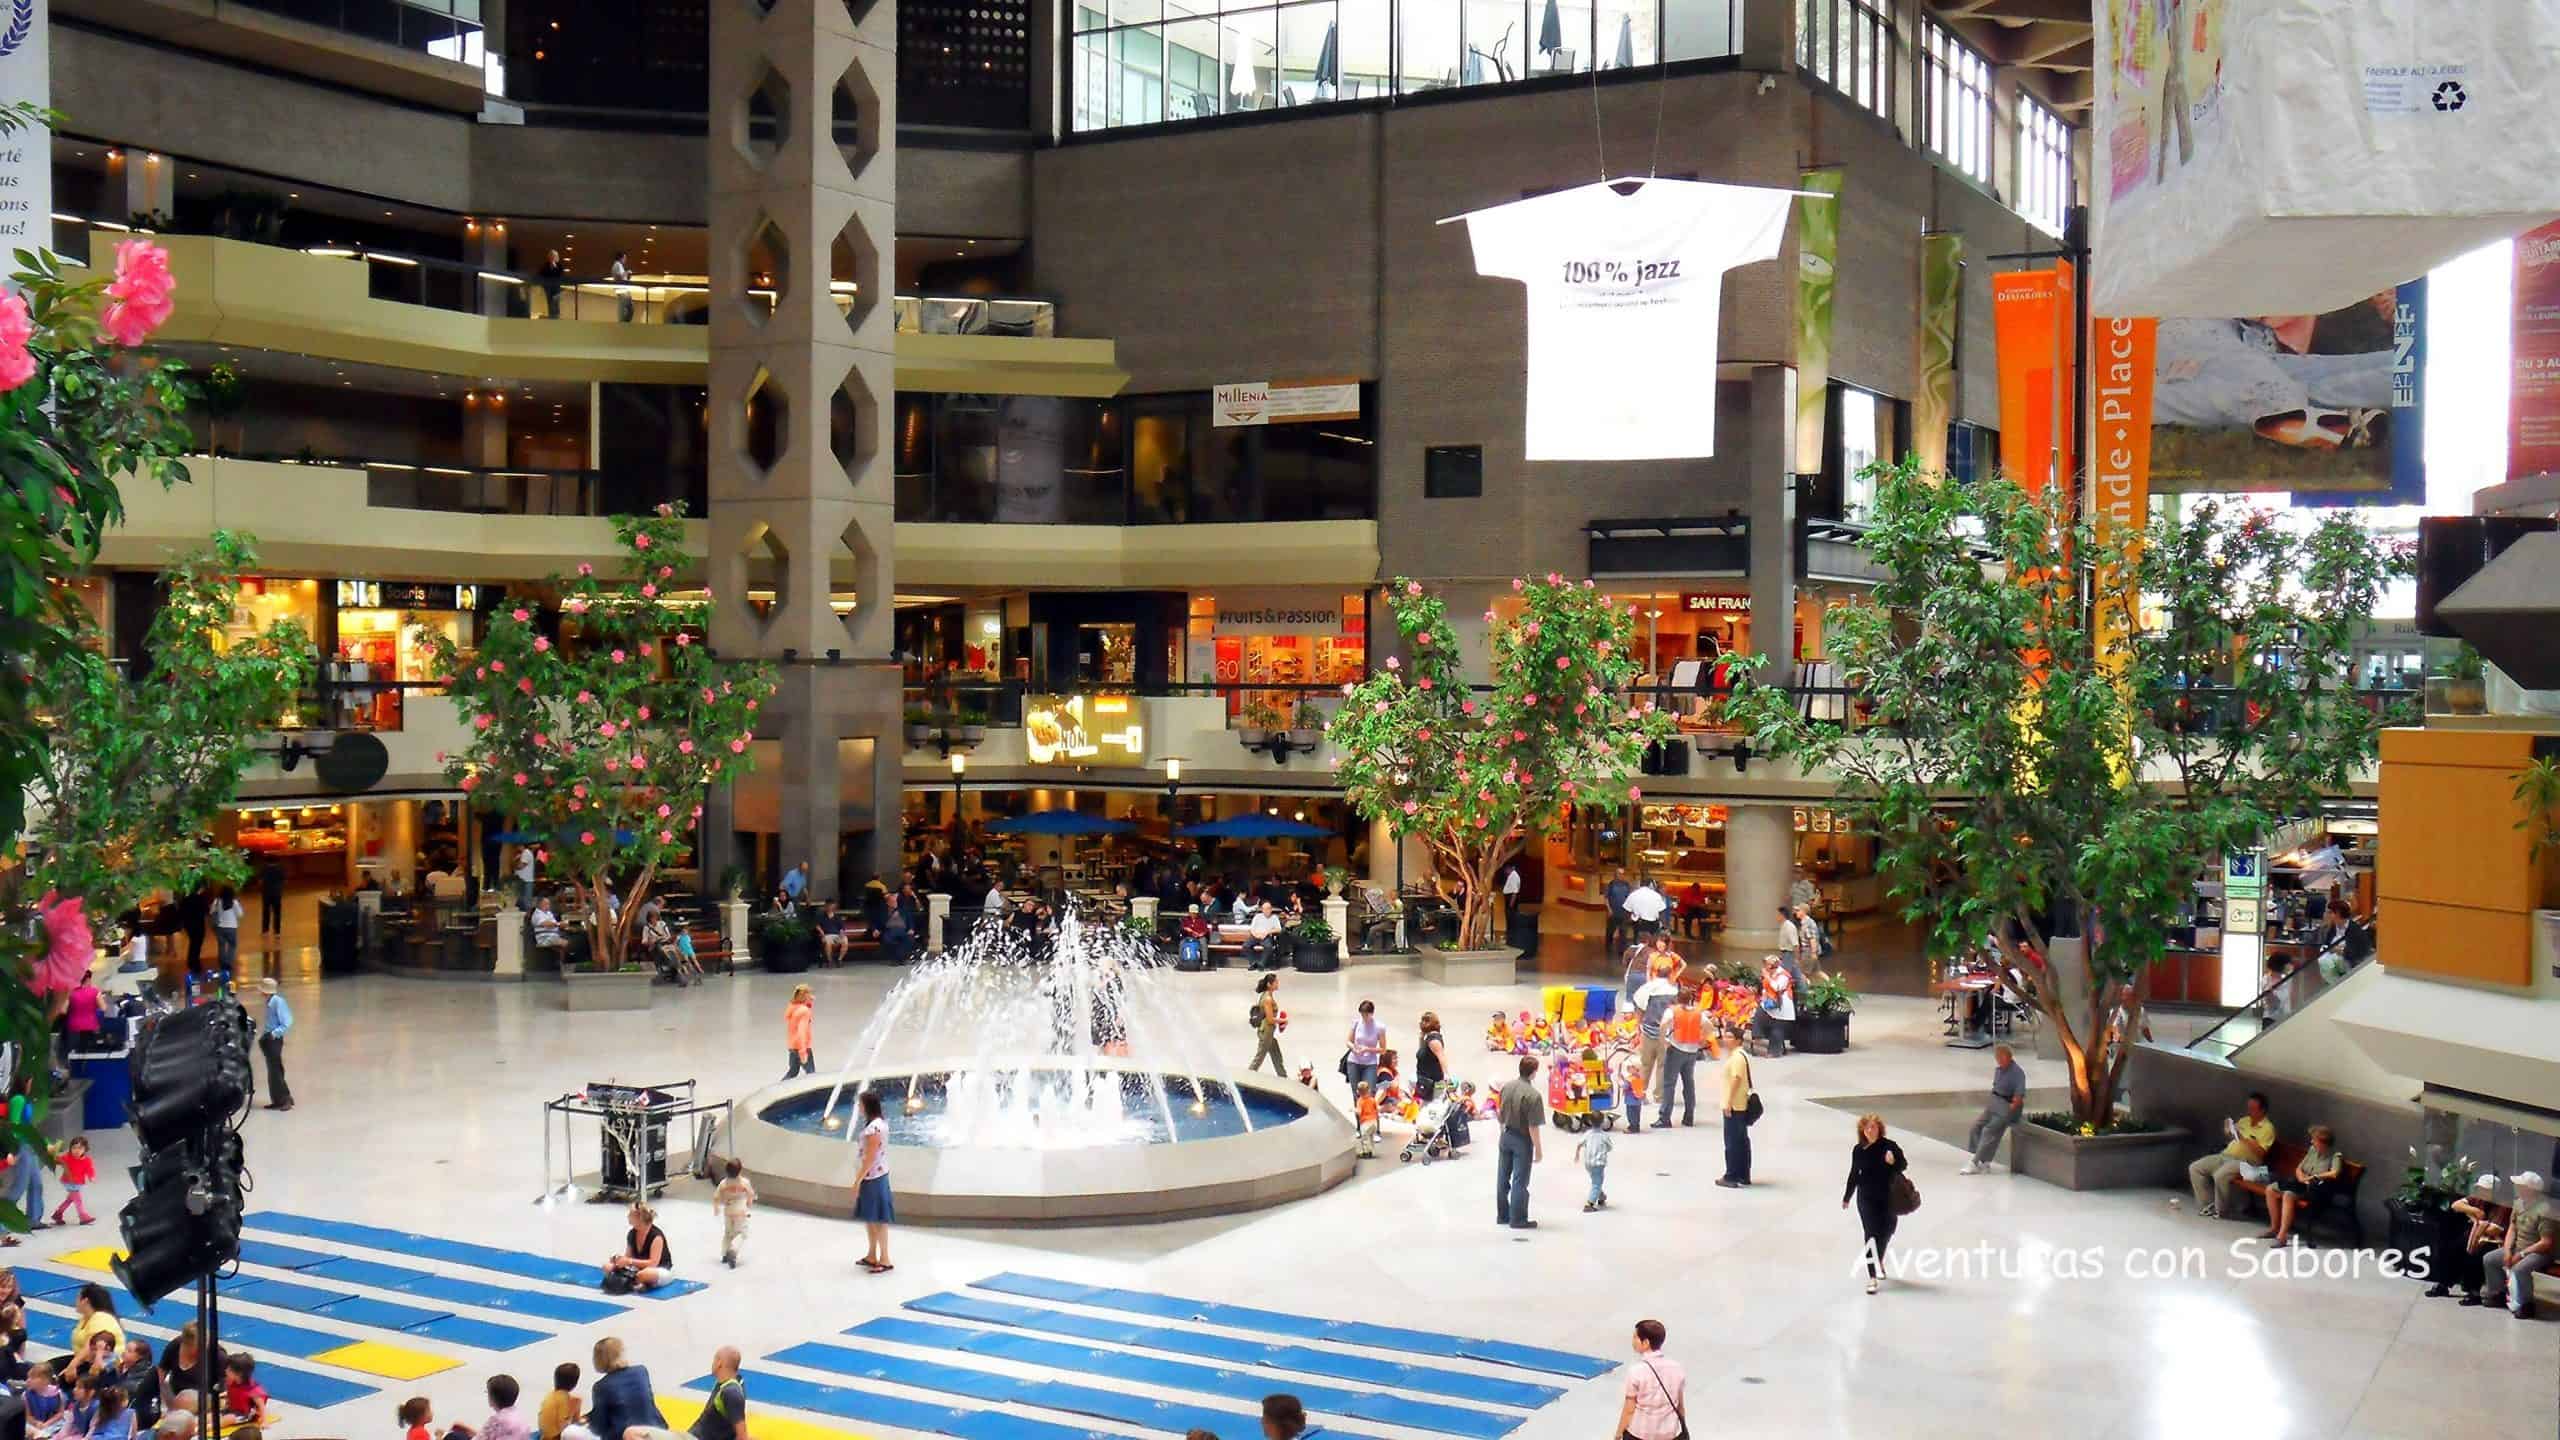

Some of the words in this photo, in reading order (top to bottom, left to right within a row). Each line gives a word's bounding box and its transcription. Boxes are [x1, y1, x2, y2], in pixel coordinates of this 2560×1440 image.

[1634, 260, 1680, 287] jazz
[2102, 317, 2132, 422] Place
[1690, 597, 1716, 609] SAN
[1718, 597, 1751, 609] FRAN
